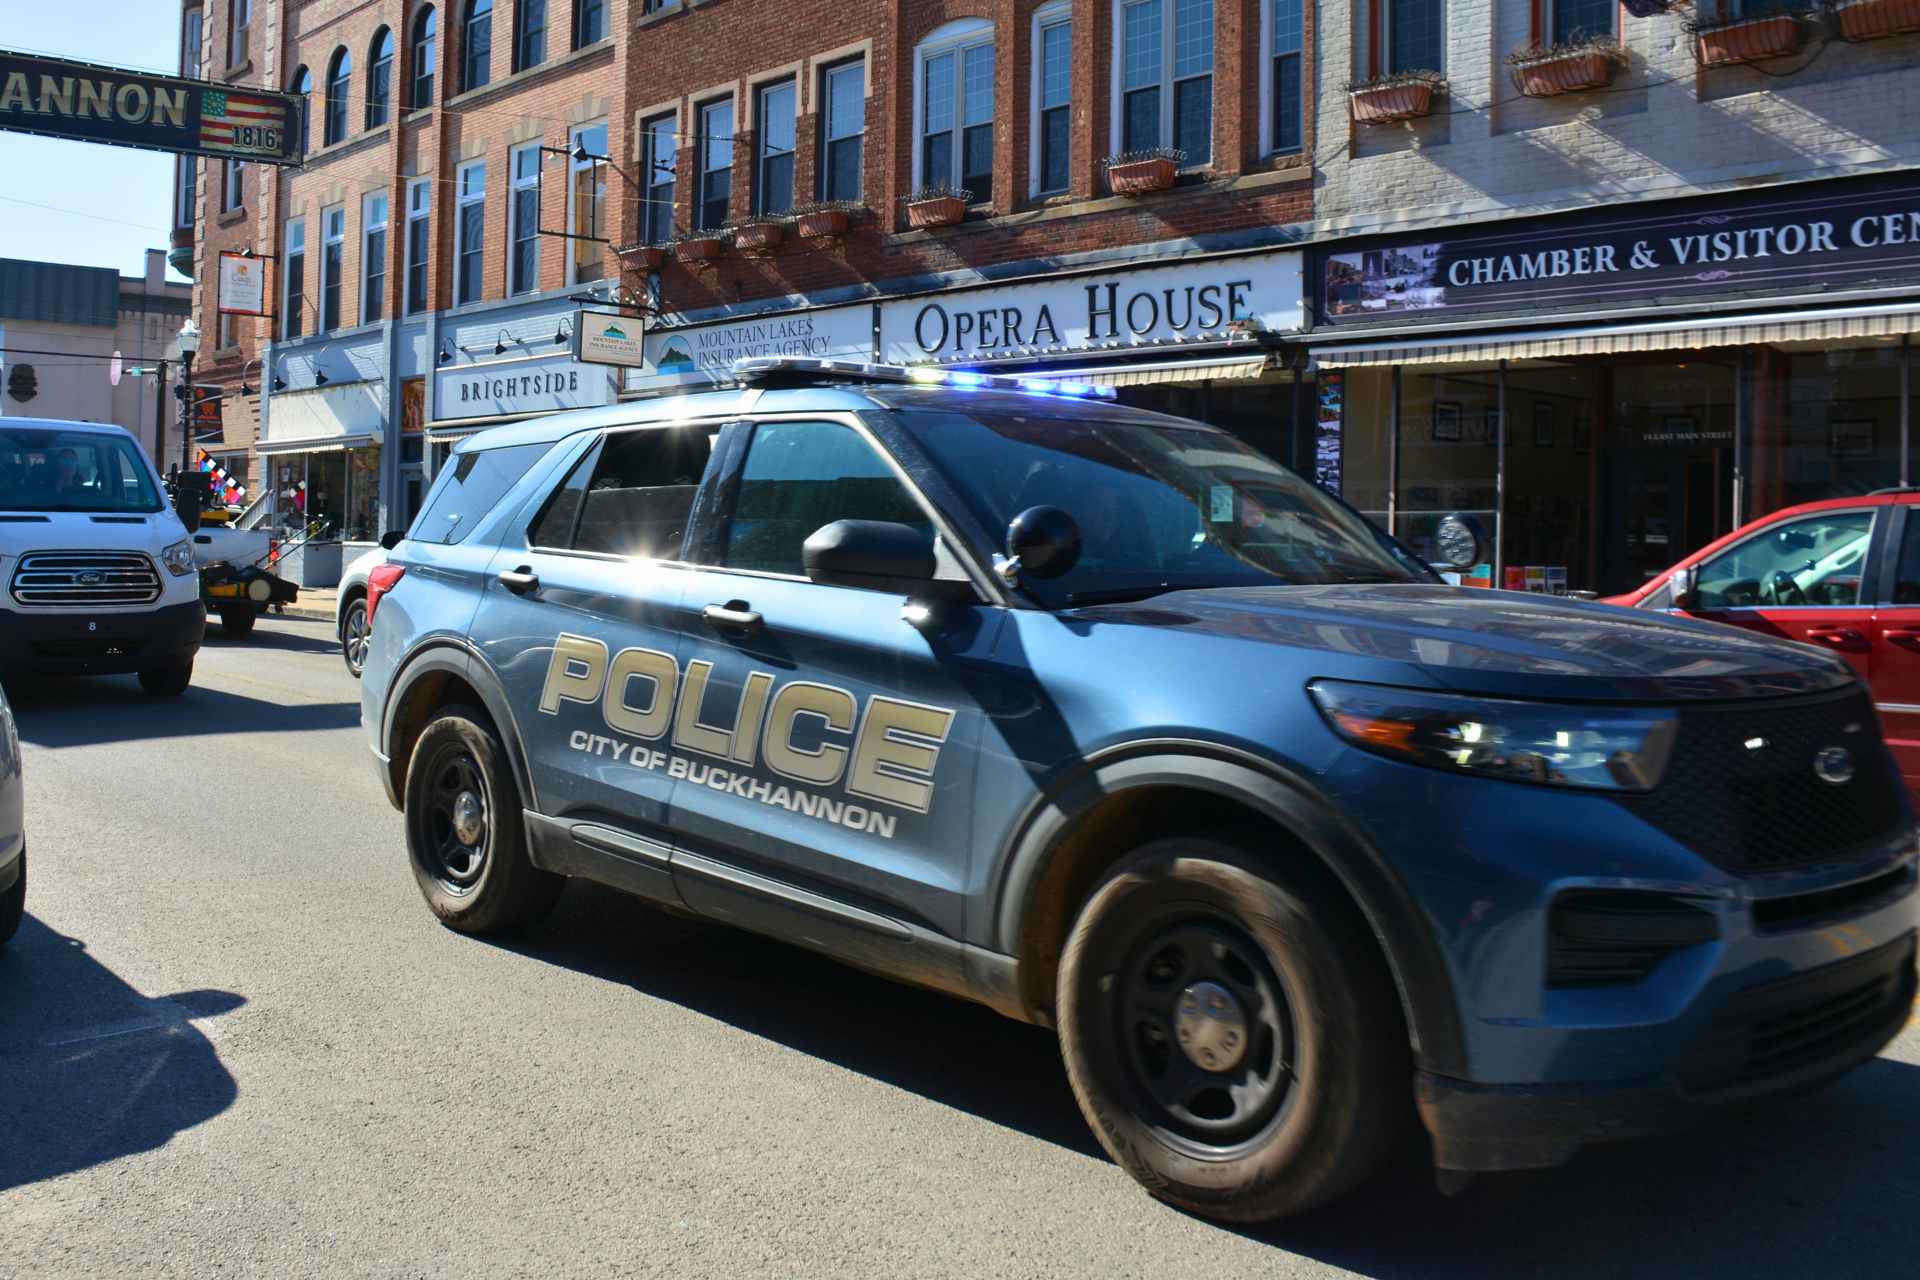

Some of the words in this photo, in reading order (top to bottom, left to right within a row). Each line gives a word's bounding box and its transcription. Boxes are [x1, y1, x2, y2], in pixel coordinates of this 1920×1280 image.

[0, 71, 189, 127] ANNON
[231, 126, 279, 150] 1816
[1449, 245, 1619, 286] CHAMBER
[1629, 240, 1660, 270] &
[1669, 222, 1839, 265] VISITOR
[698, 327, 766, 348] MOUNTAIN
[769, 318, 813, 341] LAKES
[914, 303, 1060, 354] OPERA
[1085, 280, 1253, 339] HOUSE
[698, 343, 770, 368] INSURANCE
[775, 335, 831, 358] AGENCY
[461, 371, 578, 401] BRIGHTSIDE
[88, 621, 96, 631] 8
[538, 632, 957, 814] POLICE
[569, 730, 629, 762] CITY
[629, 745, 667, 771] OF
[668, 756, 897, 839] BUCKHANNON
